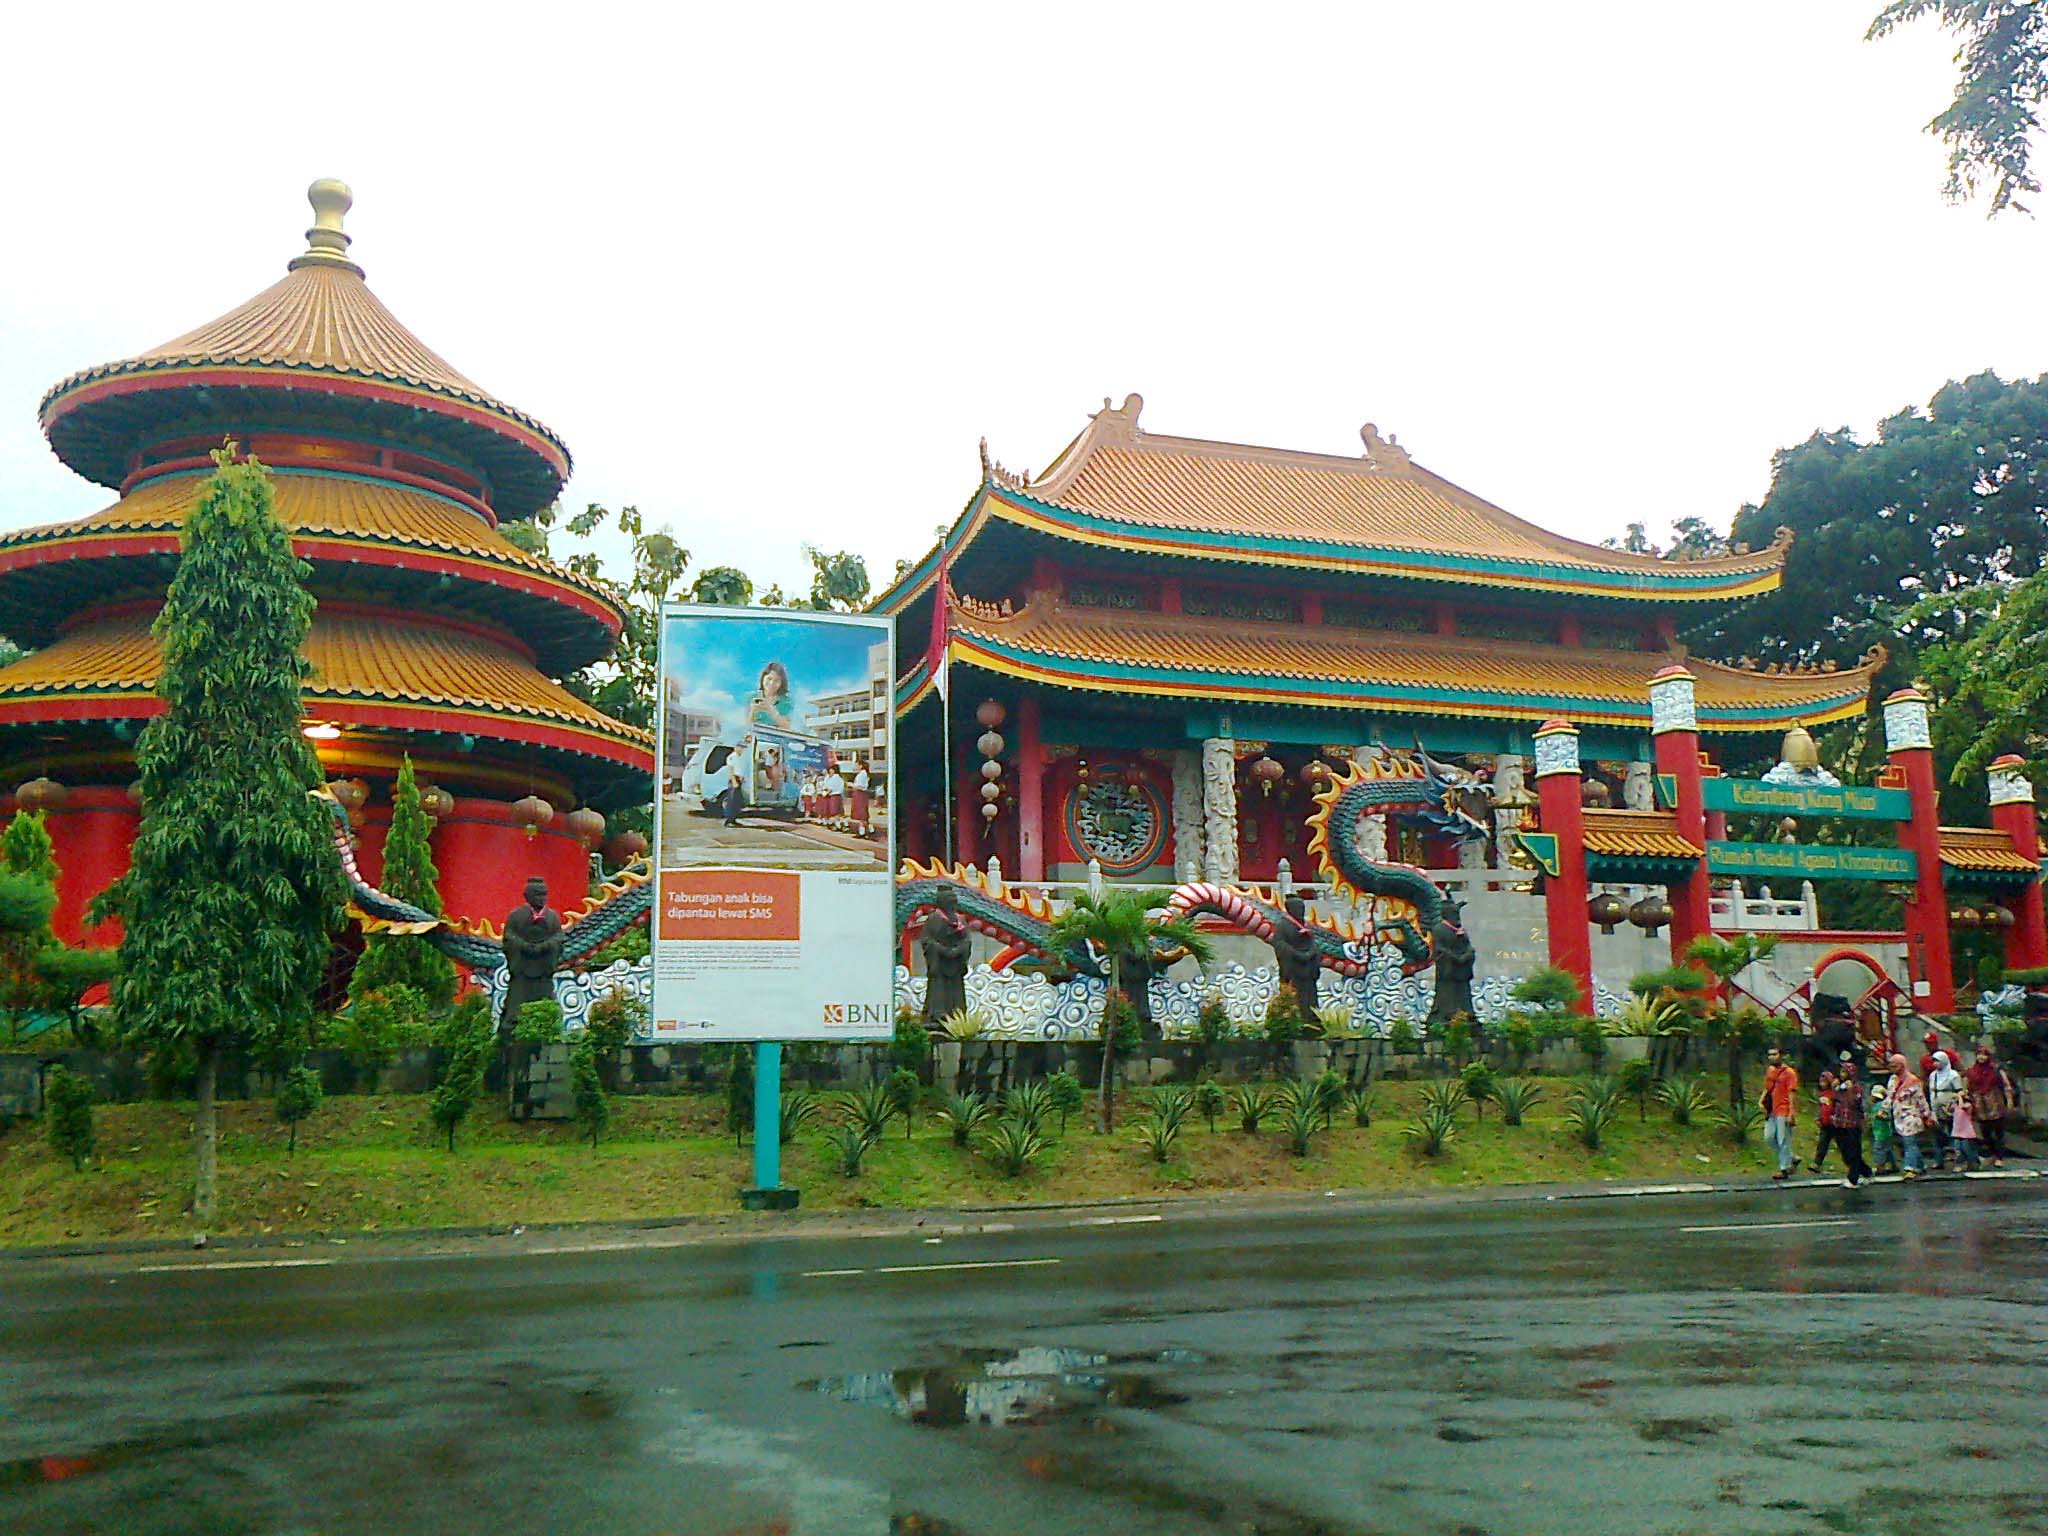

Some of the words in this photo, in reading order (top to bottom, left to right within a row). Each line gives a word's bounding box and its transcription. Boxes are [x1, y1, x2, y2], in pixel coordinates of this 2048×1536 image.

[667, 891, 723, 905] Tabungan
[724, 892, 750, 904] anak
[751, 892, 773, 904] bisa
[667, 907, 717, 920] dipantau
[718, 907, 747, 919] lewat
[749, 908, 773, 919] SMS
[847, 1004, 888, 1023] BNI
